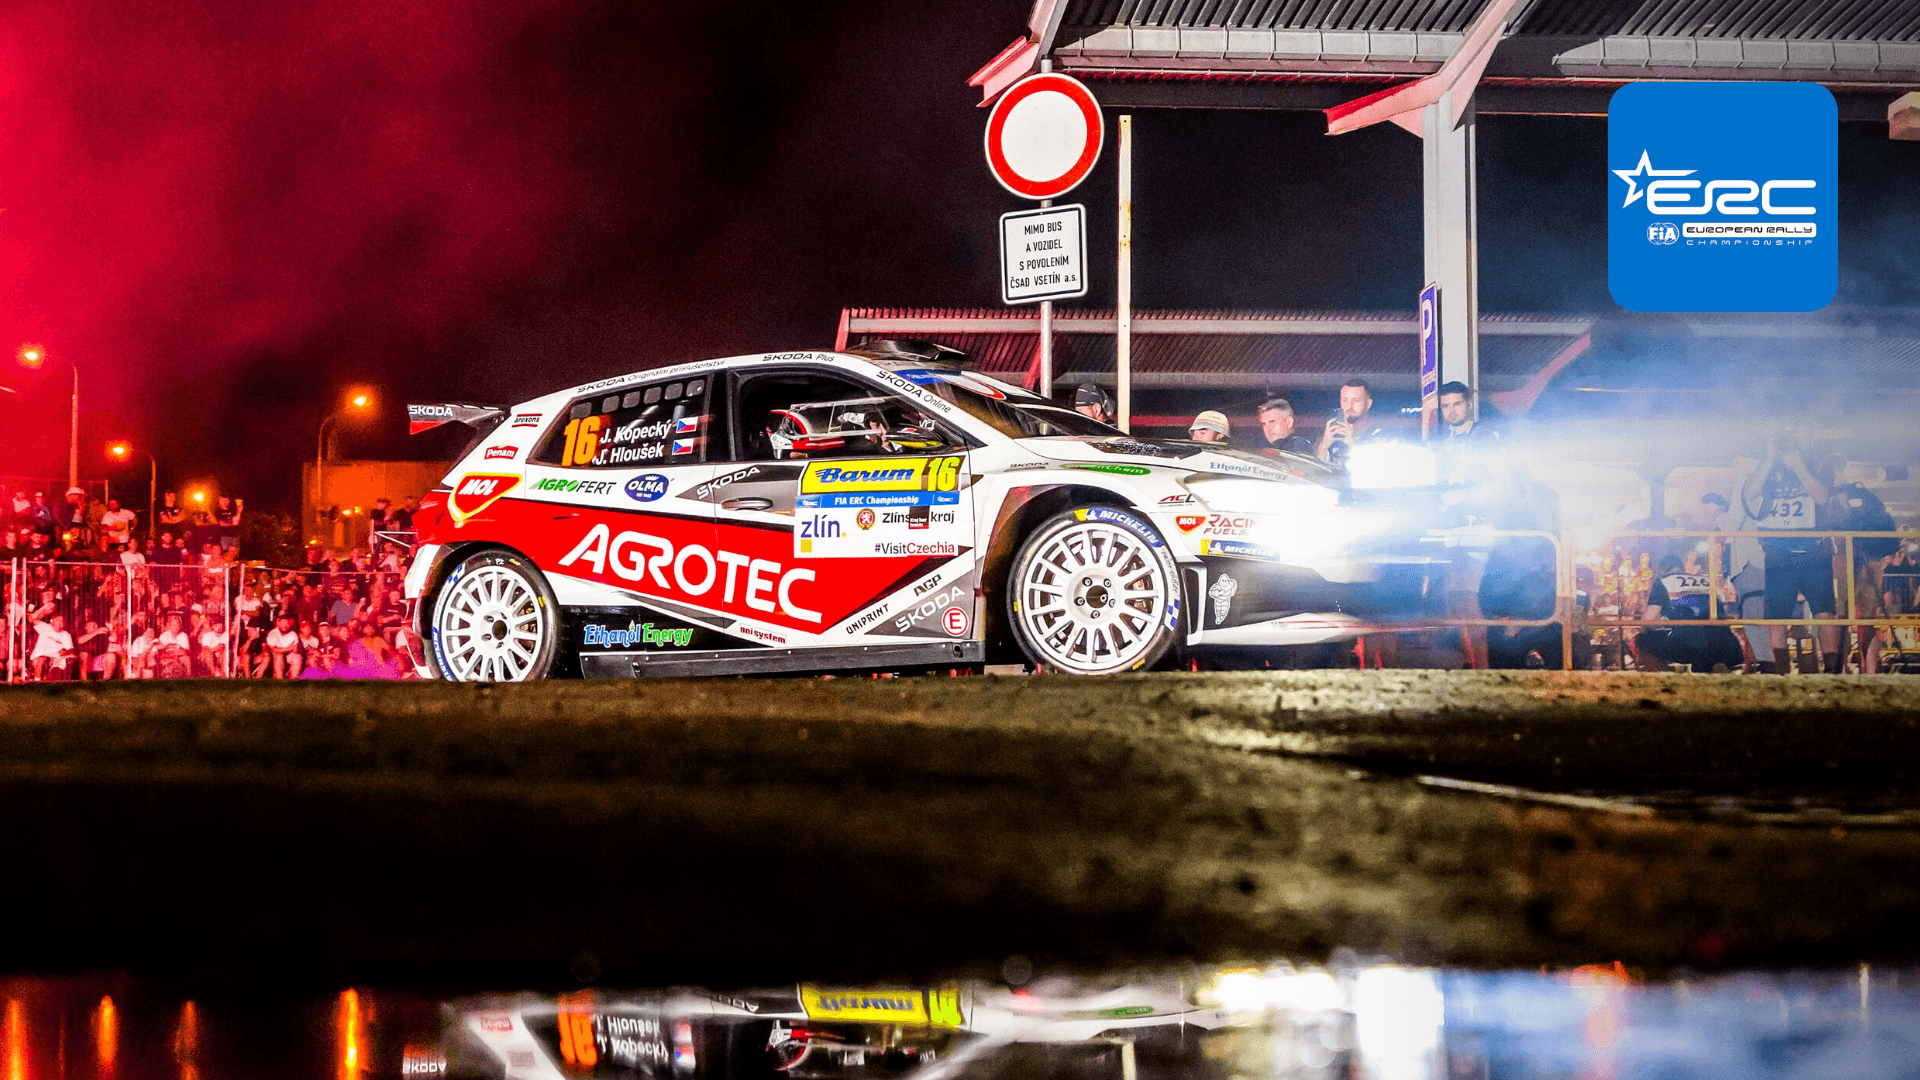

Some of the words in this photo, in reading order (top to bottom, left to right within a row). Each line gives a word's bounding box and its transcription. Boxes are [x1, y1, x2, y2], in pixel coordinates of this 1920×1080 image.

[1024, 223, 1045, 235] MIMO
[1047, 221, 1063, 233] BUS
[1026, 243, 1032, 253] A
[1033, 239, 1063, 251] VOZIDEL
[1019, 261, 1025, 271] S
[1027, 254, 1070, 270] POVOLENÍM
[1010, 276, 1030, 289] ČSAD
[1034, 272, 1061, 286] VSETÍN
[1064, 274, 1078, 282] a.s.
[1422, 298, 1433, 366] P
[815, 352, 836, 363] Plus
[923, 394, 952, 414] Online
[600, 428, 612, 444] J.
[614, 419, 672, 444] Kopecký
[562, 416, 601, 467] 16
[486, 448, 515, 458] Penam
[594, 449, 607, 465] J.
[610, 442, 665, 463] Hloušek
[815, 468, 915, 485] Barum
[927, 457, 960, 491] 16
[1210, 461, 1252, 472] Ethanol
[1252, 467, 1288, 480] Energy
[458, 479, 499, 496] MOL
[529, 478, 618, 496] AGROFERT
[628, 480, 665, 493] OLMA
[834, 496, 848, 505] FIA
[850, 496, 865, 505] ERC
[866, 495, 920, 505] Championship
[1160, 493, 1195, 503] ACL
[930, 510, 955, 525] kraj
[1178, 517, 1196, 525] MOL
[1099, 510, 1160, 544] MICHELIN
[875, 541, 955, 555] #VisitCzechia
[557, 523, 823, 624] AGROTEC
[913, 574, 942, 597] AGP
[846, 603, 889, 634] UNIPRINT
[584, 621, 642, 648] Ethanol
[642, 623, 694, 647] Energy
